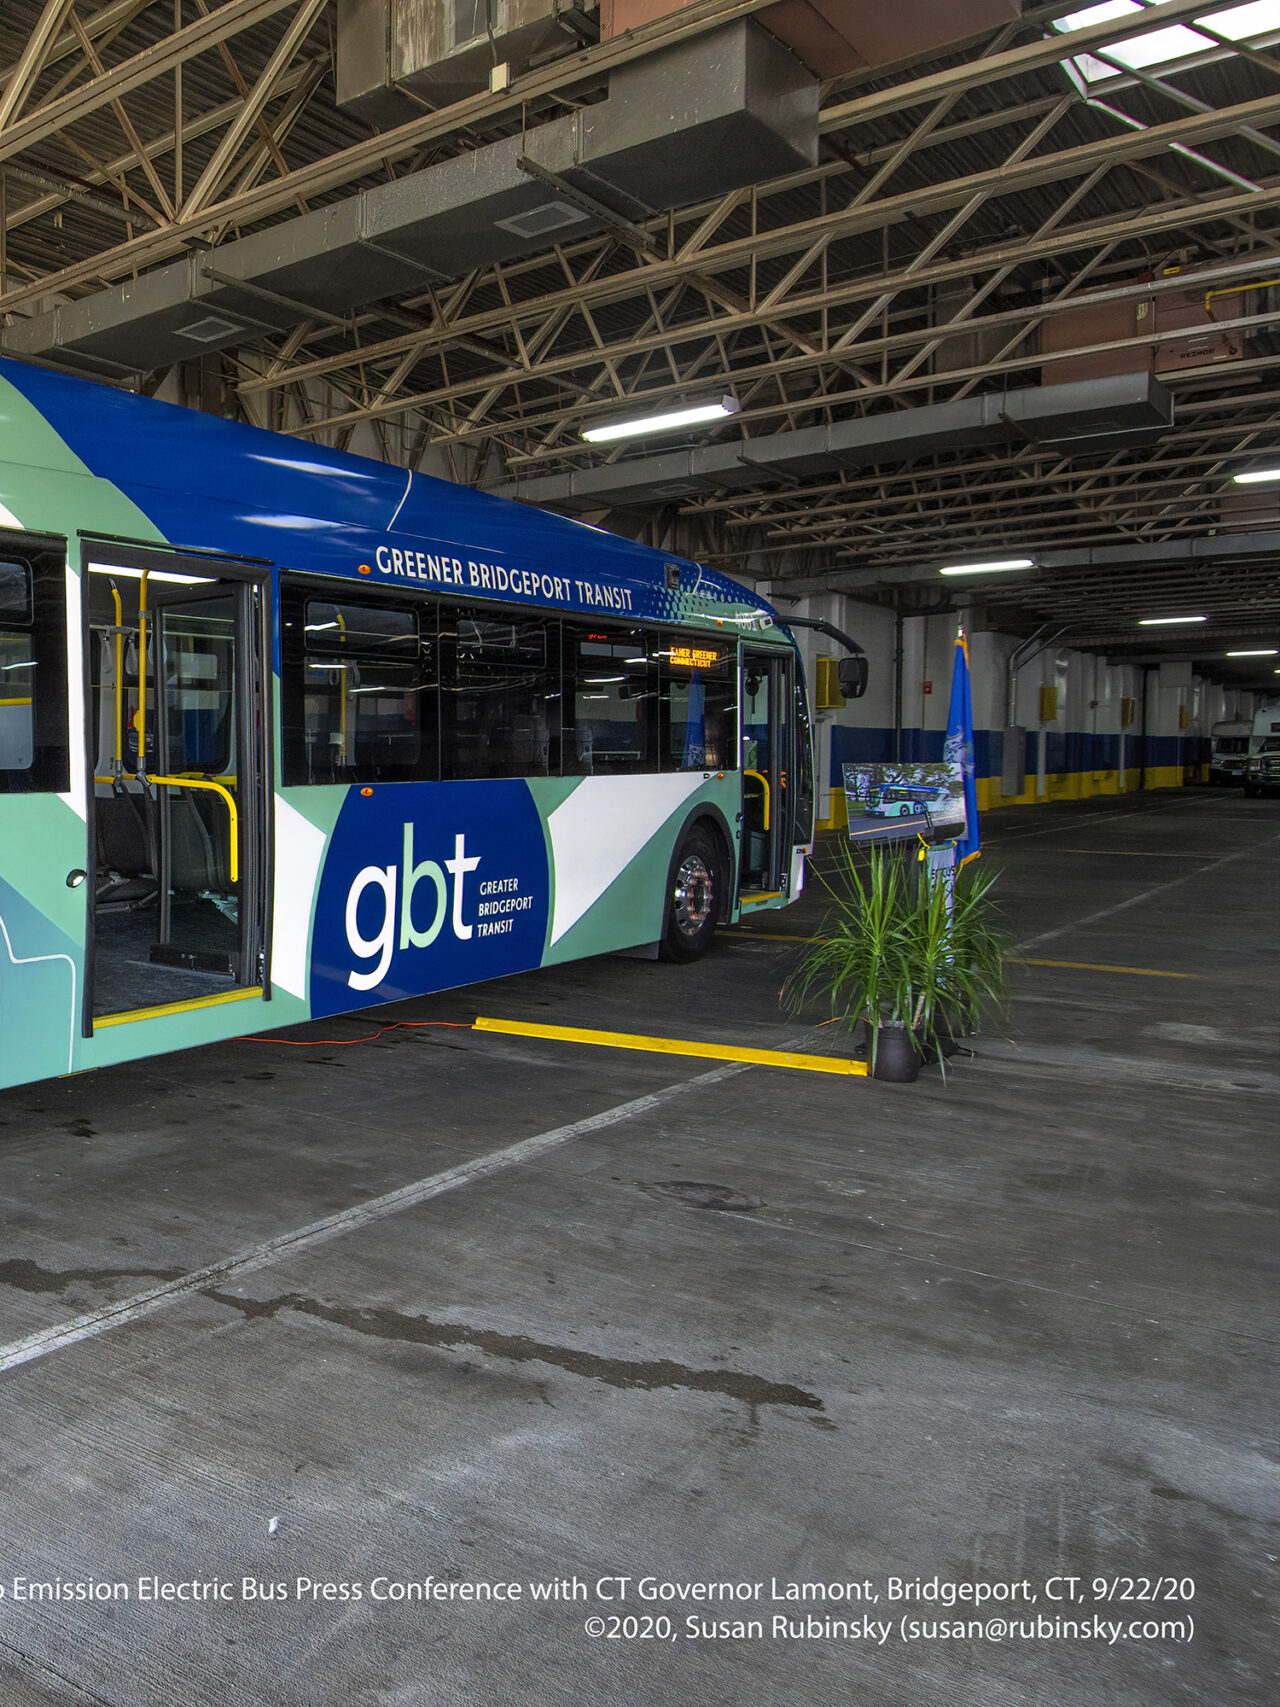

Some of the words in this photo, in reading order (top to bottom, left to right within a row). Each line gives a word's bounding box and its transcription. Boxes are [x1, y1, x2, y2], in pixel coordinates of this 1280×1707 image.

[376, 546, 464, 585] GREENER
[468, 561, 571, 601] BRIDGEPORT
[575, 580, 632, 611] TRANSIT
[670, 656, 711, 668] CONNECTICUT
[479, 877, 519, 896] GREATER
[345, 822, 482, 991] gbt
[478, 896, 534, 917] BRIDGEPORT
[477, 918, 514, 938] TRANSIT
